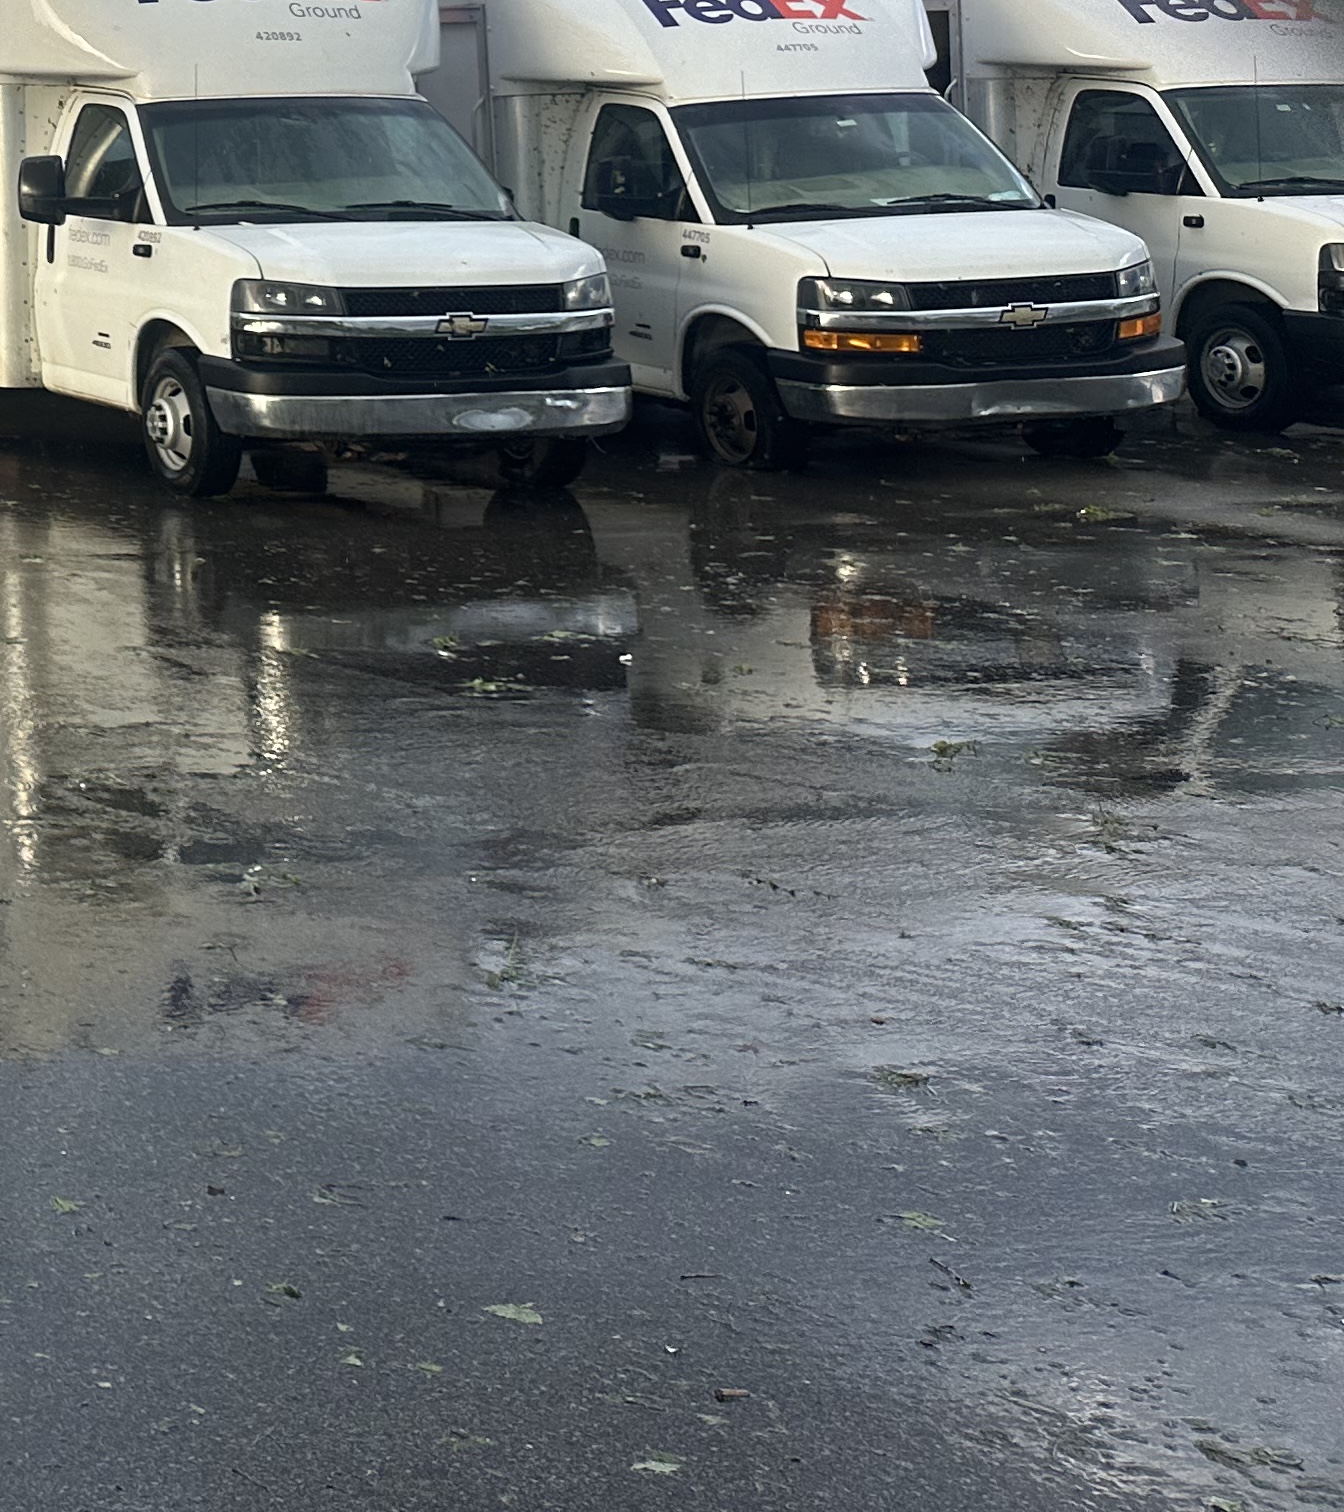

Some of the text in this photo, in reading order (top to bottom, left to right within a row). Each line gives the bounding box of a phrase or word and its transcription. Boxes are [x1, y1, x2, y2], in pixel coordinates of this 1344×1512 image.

[288, 2, 362, 19] Ground
[255, 31, 302, 41] 420892
[792, 21, 863, 35] Ground
[776, 43, 819, 52] 447705
[68, 225, 111, 247] fedex.com
[682, 228, 711, 244] 447705
[594, 243, 646, 264] dex.com
